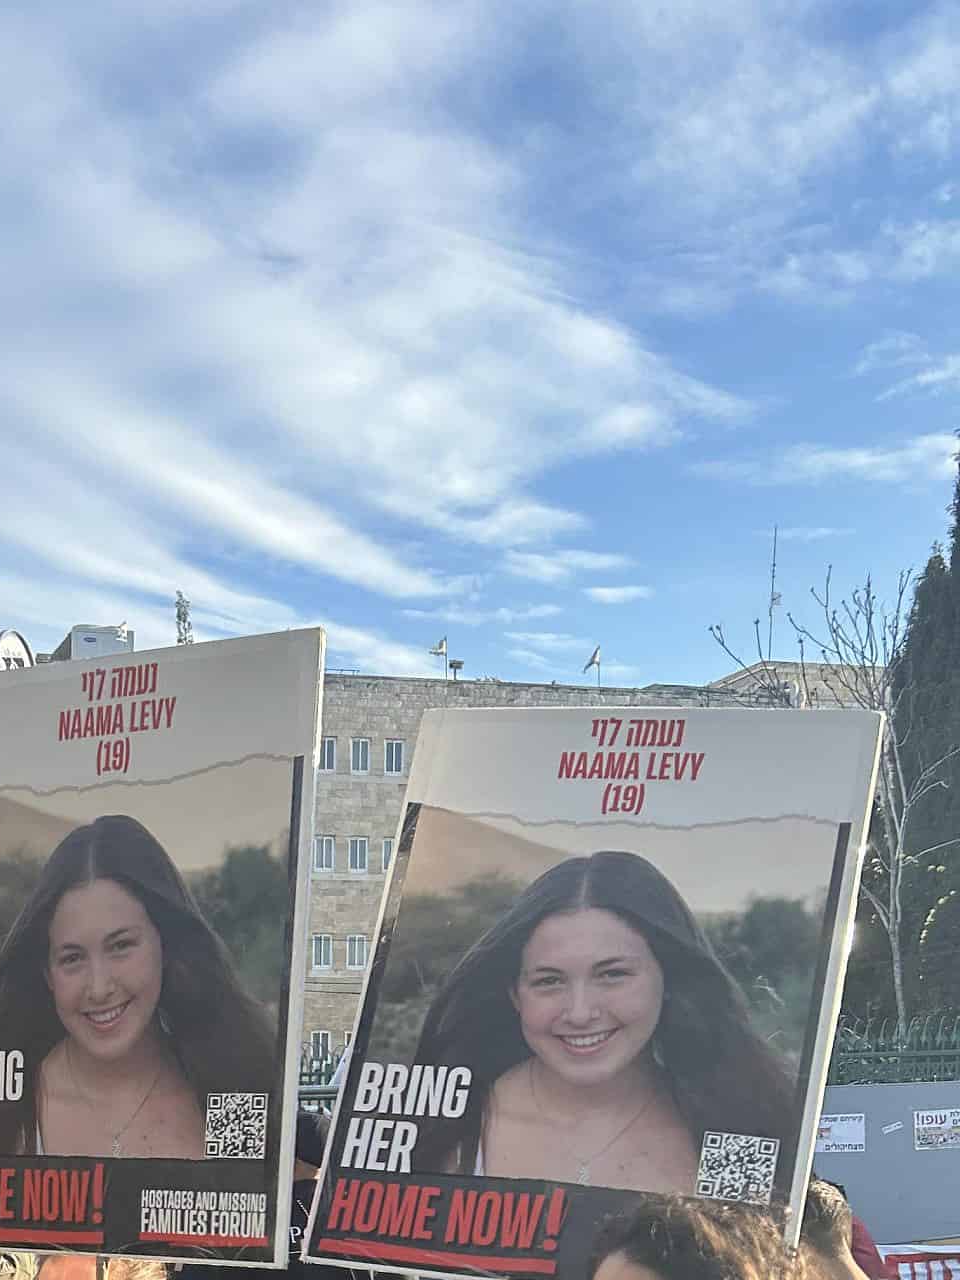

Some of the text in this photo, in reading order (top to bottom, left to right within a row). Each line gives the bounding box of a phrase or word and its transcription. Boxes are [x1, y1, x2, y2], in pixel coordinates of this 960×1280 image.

[81, 662, 158, 702] נעמה לוי
[59, 696, 177, 742] NAAMA LEVY
[591, 717, 686, 747] נעמה לוי
[96, 736, 130, 776] (19)
[557, 751, 705, 781] NAAMA LEVY
[601, 783, 646, 816] (19)
[353, 1062, 473, 1118] BRING
[340, 1117, 418, 1174] HER
[22, 1162, 105, 1225] NOW!
[141, 1189, 267, 1213] HOSTAGES AND MISSING
[140, 1207, 208, 1236] FAMILIES
[210, 1210, 266, 1239] FORUM
[327, 1177, 566, 1252] HOME NOW!
